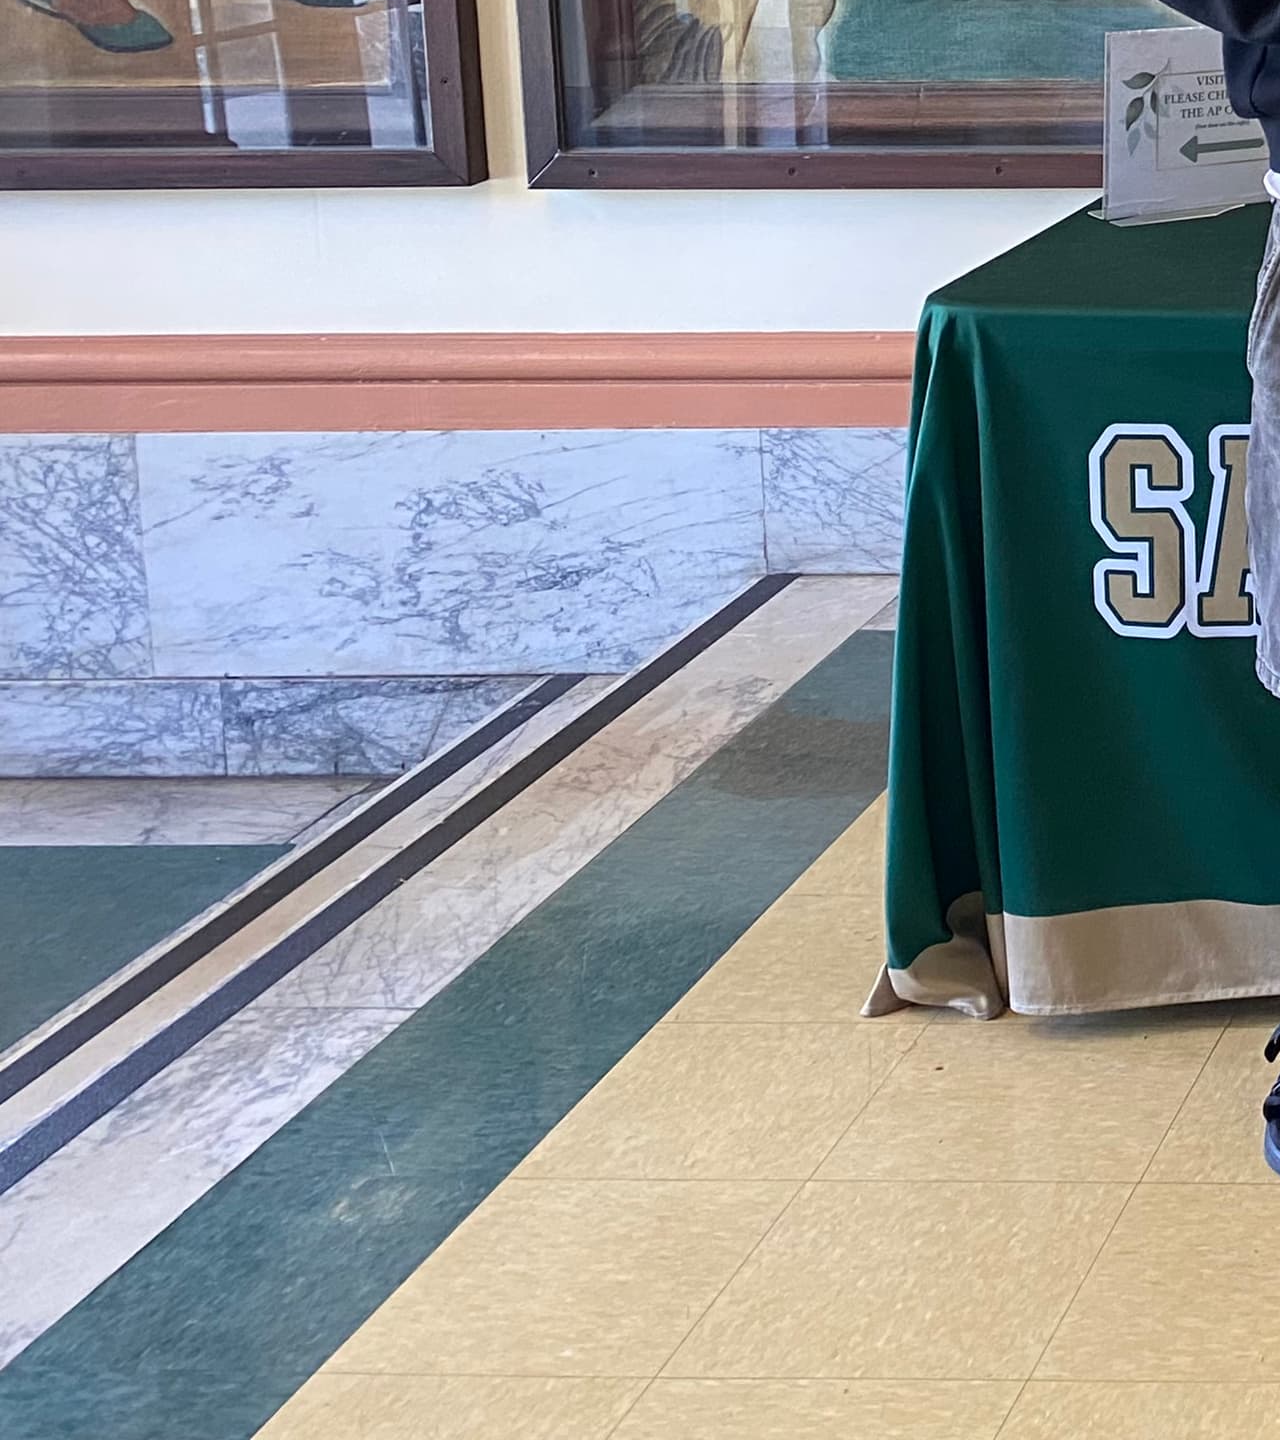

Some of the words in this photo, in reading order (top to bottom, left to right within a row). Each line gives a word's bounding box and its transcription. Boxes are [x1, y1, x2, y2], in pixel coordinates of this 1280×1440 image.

[1164, 91, 1206, 105] PLEASE
[1181, 107, 1204, 119] THE
[1206, 105, 1222, 117] AP
